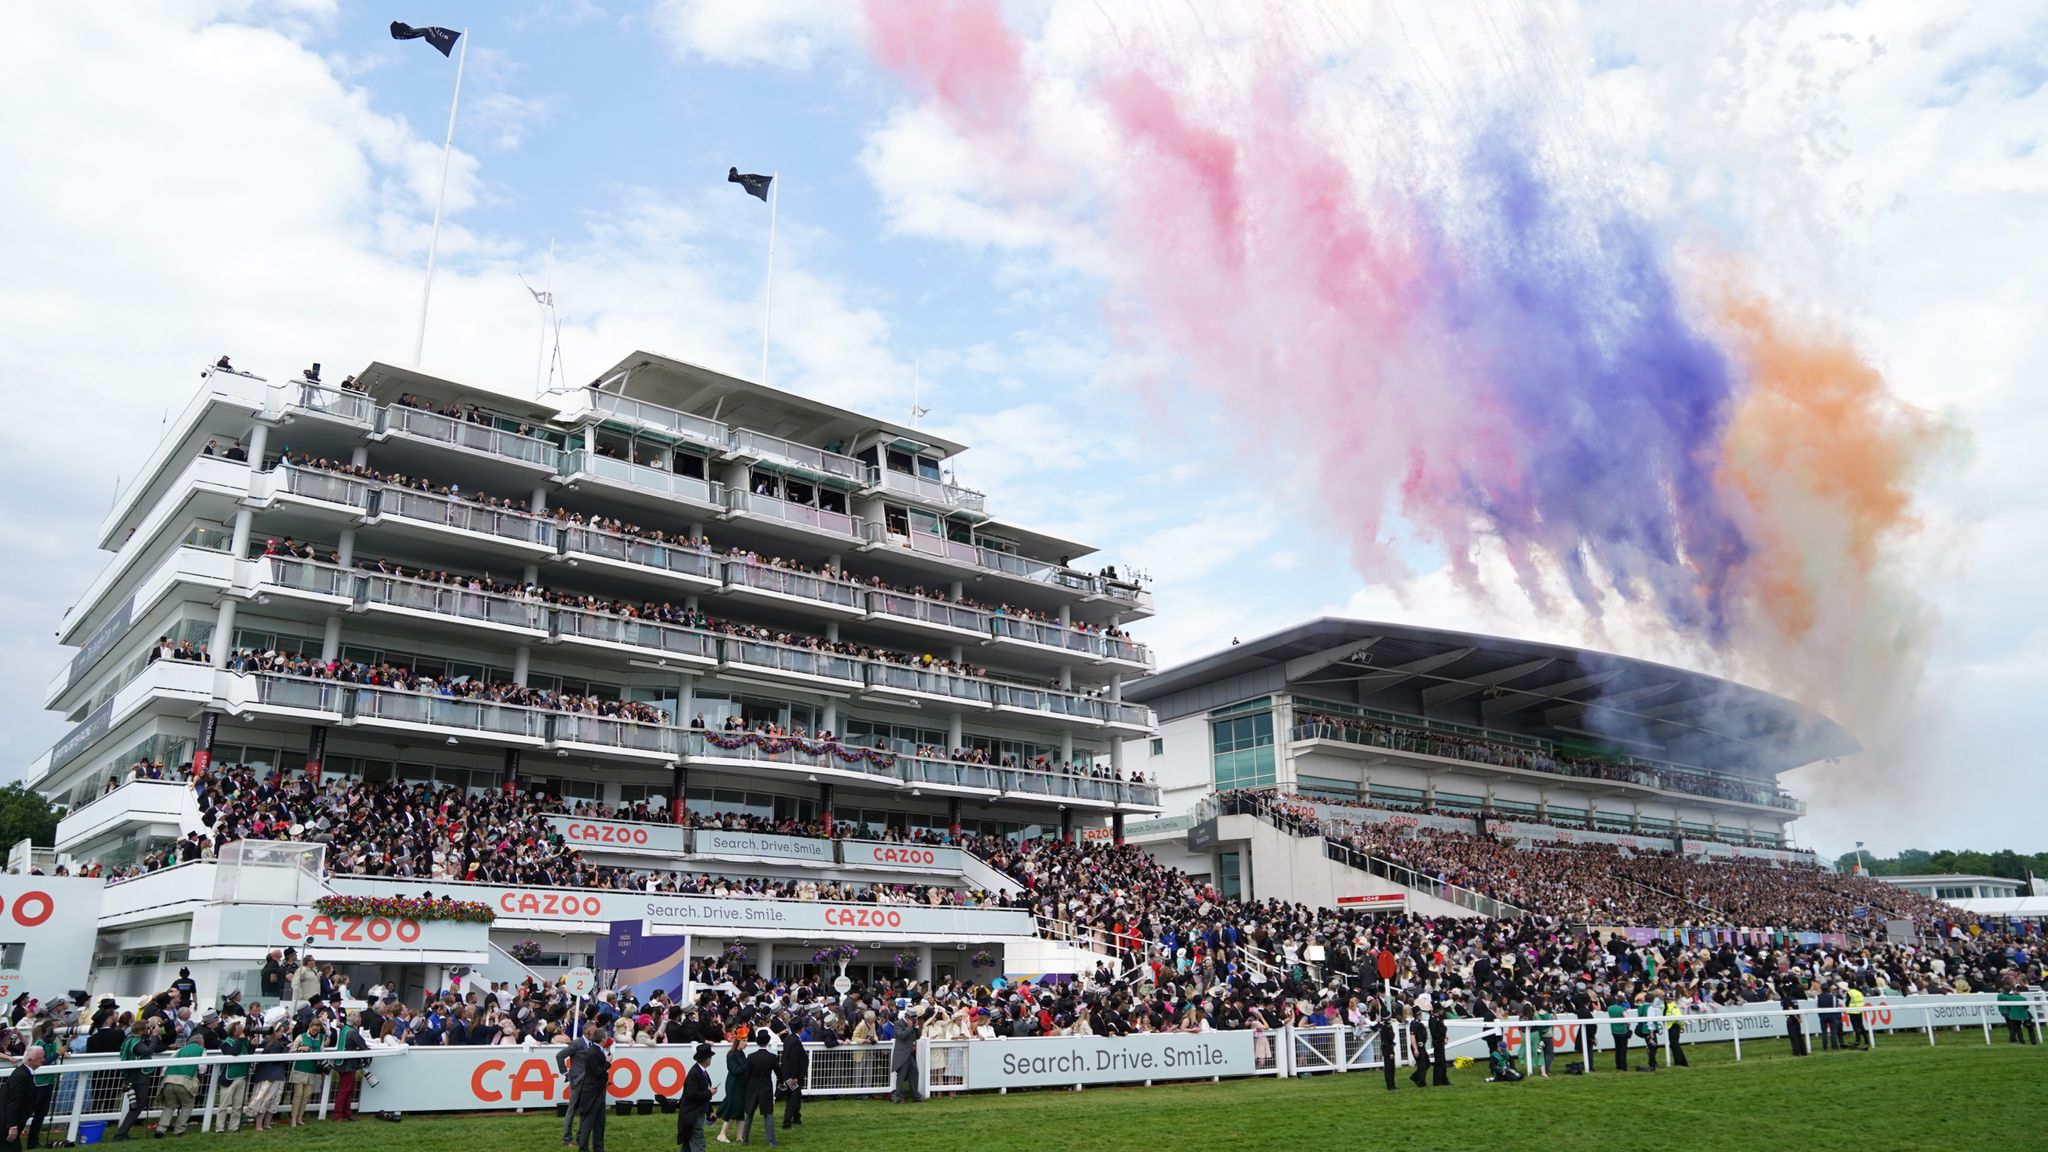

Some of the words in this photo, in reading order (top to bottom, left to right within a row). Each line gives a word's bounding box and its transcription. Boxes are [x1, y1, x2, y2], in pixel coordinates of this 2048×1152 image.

[1389, 815, 1418, 826] CAZOO
[568, 823, 648, 845] CAZOO
[713, 837, 759, 851] Search.
[761, 840, 793, 852] Drive.
[794, 842, 824, 856] Smile.
[873, 847, 934, 865] CAZOO
[500, 892, 600, 917] CAZOO
[647, 903, 700, 918] Search.
[703, 906, 742, 920] Drive.
[745, 908, 786, 921] Smile.
[825, 908, 900, 928] CAZOO
[281, 914, 421, 943] CAZOO
[0, 985, 8, 998] 3
[576, 979, 584, 991] 2
[1003, 1049, 1091, 1075] Search.
[1096, 1048, 1158, 1071] Drive.
[1164, 1044, 1228, 1067] Smile.
